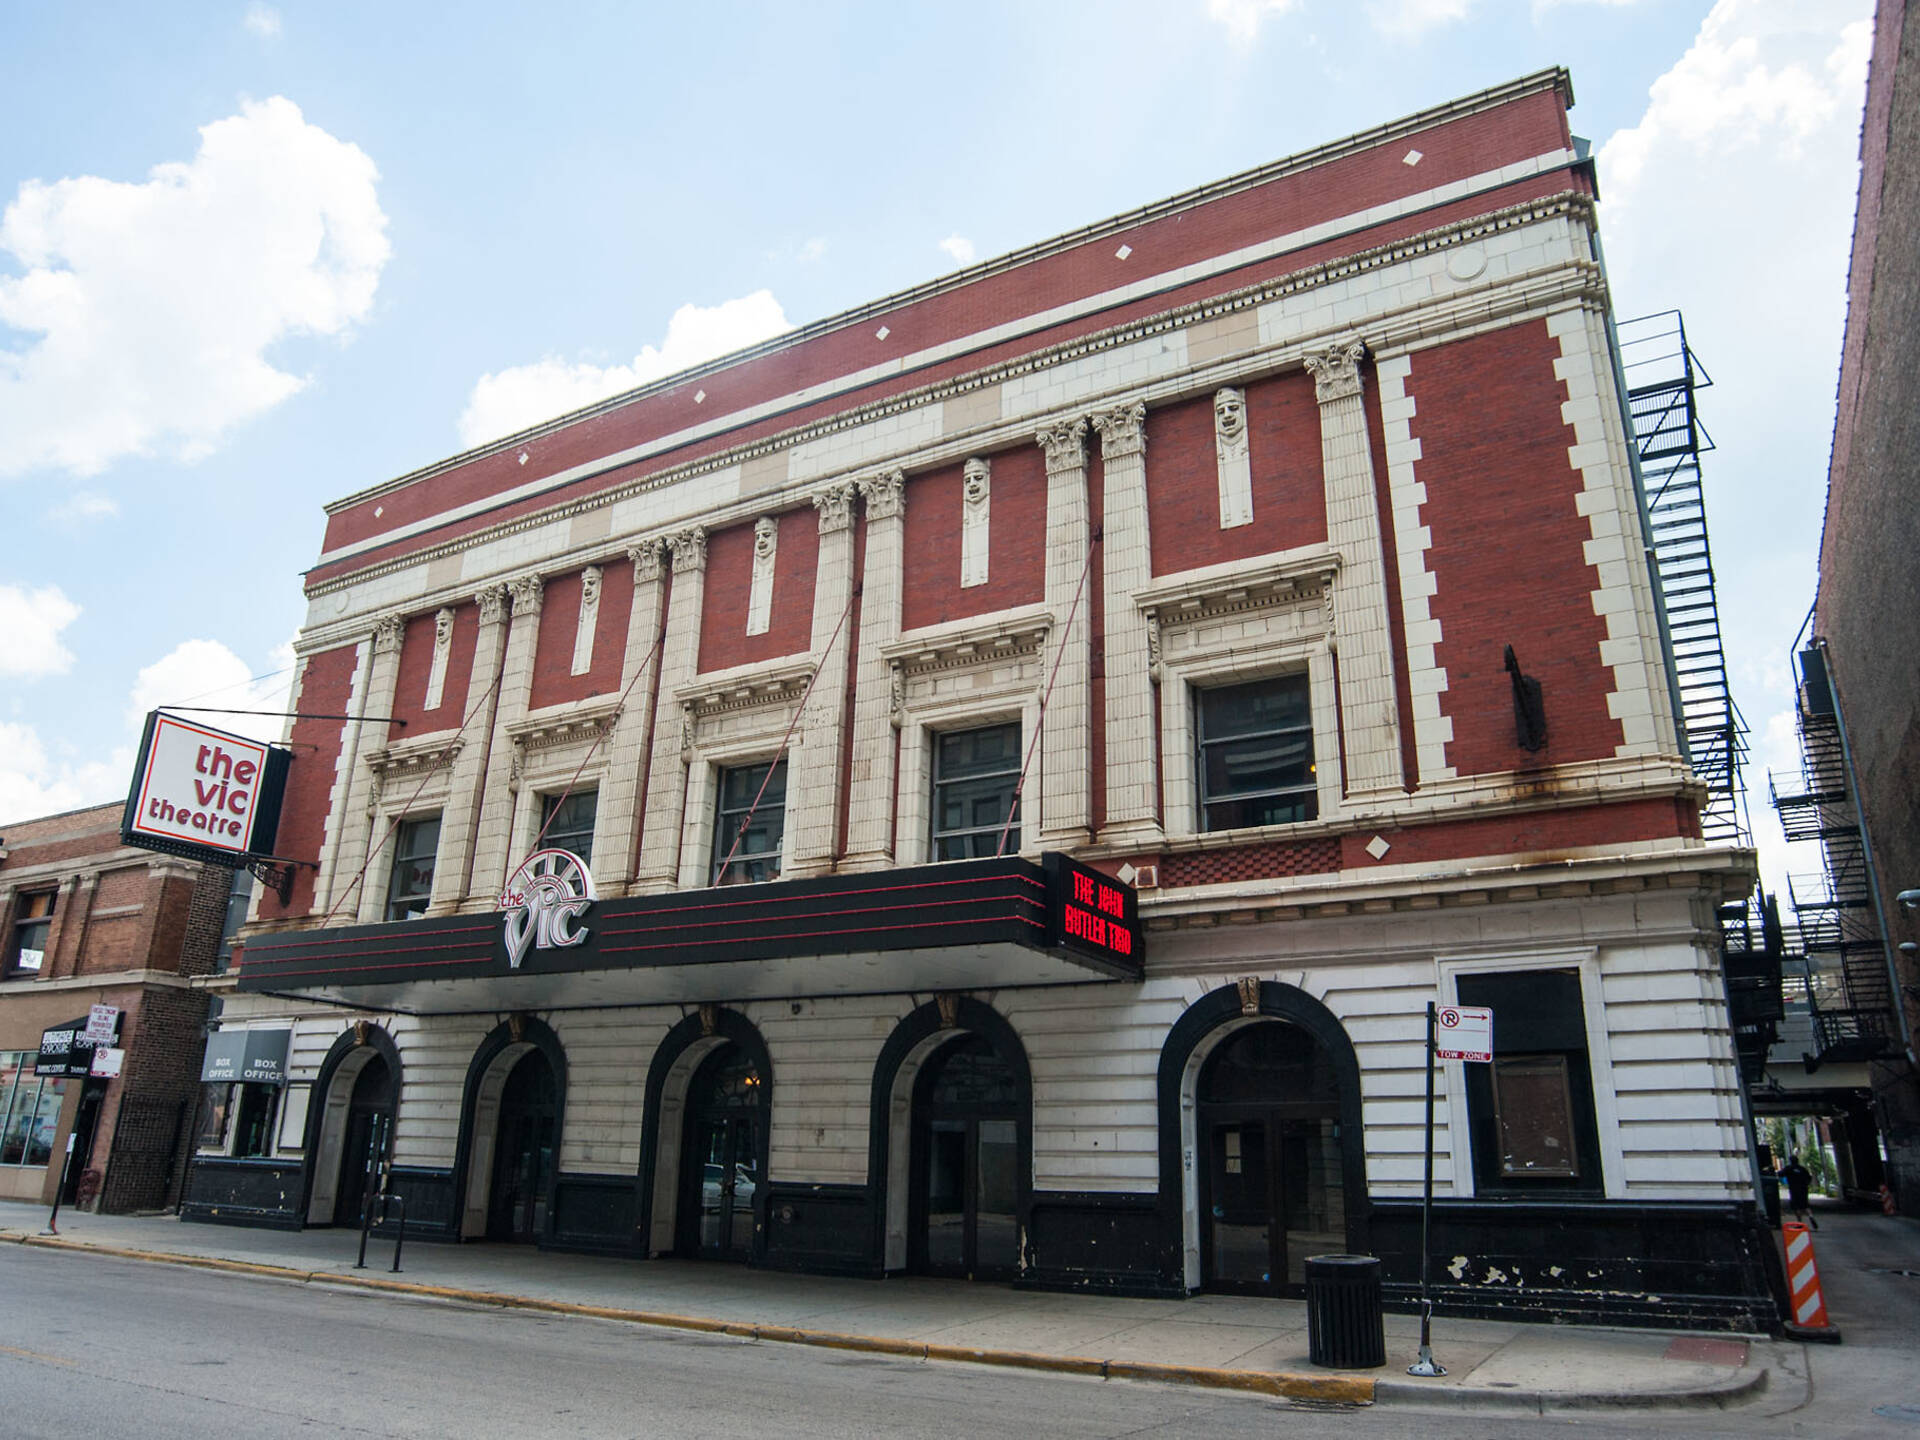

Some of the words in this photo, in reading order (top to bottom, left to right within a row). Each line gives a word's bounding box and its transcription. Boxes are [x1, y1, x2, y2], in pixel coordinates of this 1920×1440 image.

[195, 744, 257, 785] the
[194, 779, 249, 815] vic
[149, 797, 242, 838] theatre
[500, 888, 524, 907] the
[1072, 870, 1094, 906] THE
[1098, 883, 1124, 919] JOHN
[1065, 903, 1106, 946] BUTLER
[1107, 922, 1131, 955] TRIO
[215, 1058, 231, 1067] BOX
[254, 1059, 278, 1069] BOX
[1441, 1050, 1458, 1059] TOW
[1463, 1051, 1486, 1060] ZONE
[208, 1069, 234, 1078] OFFICE
[244, 1069, 283, 1080] OFFICE
